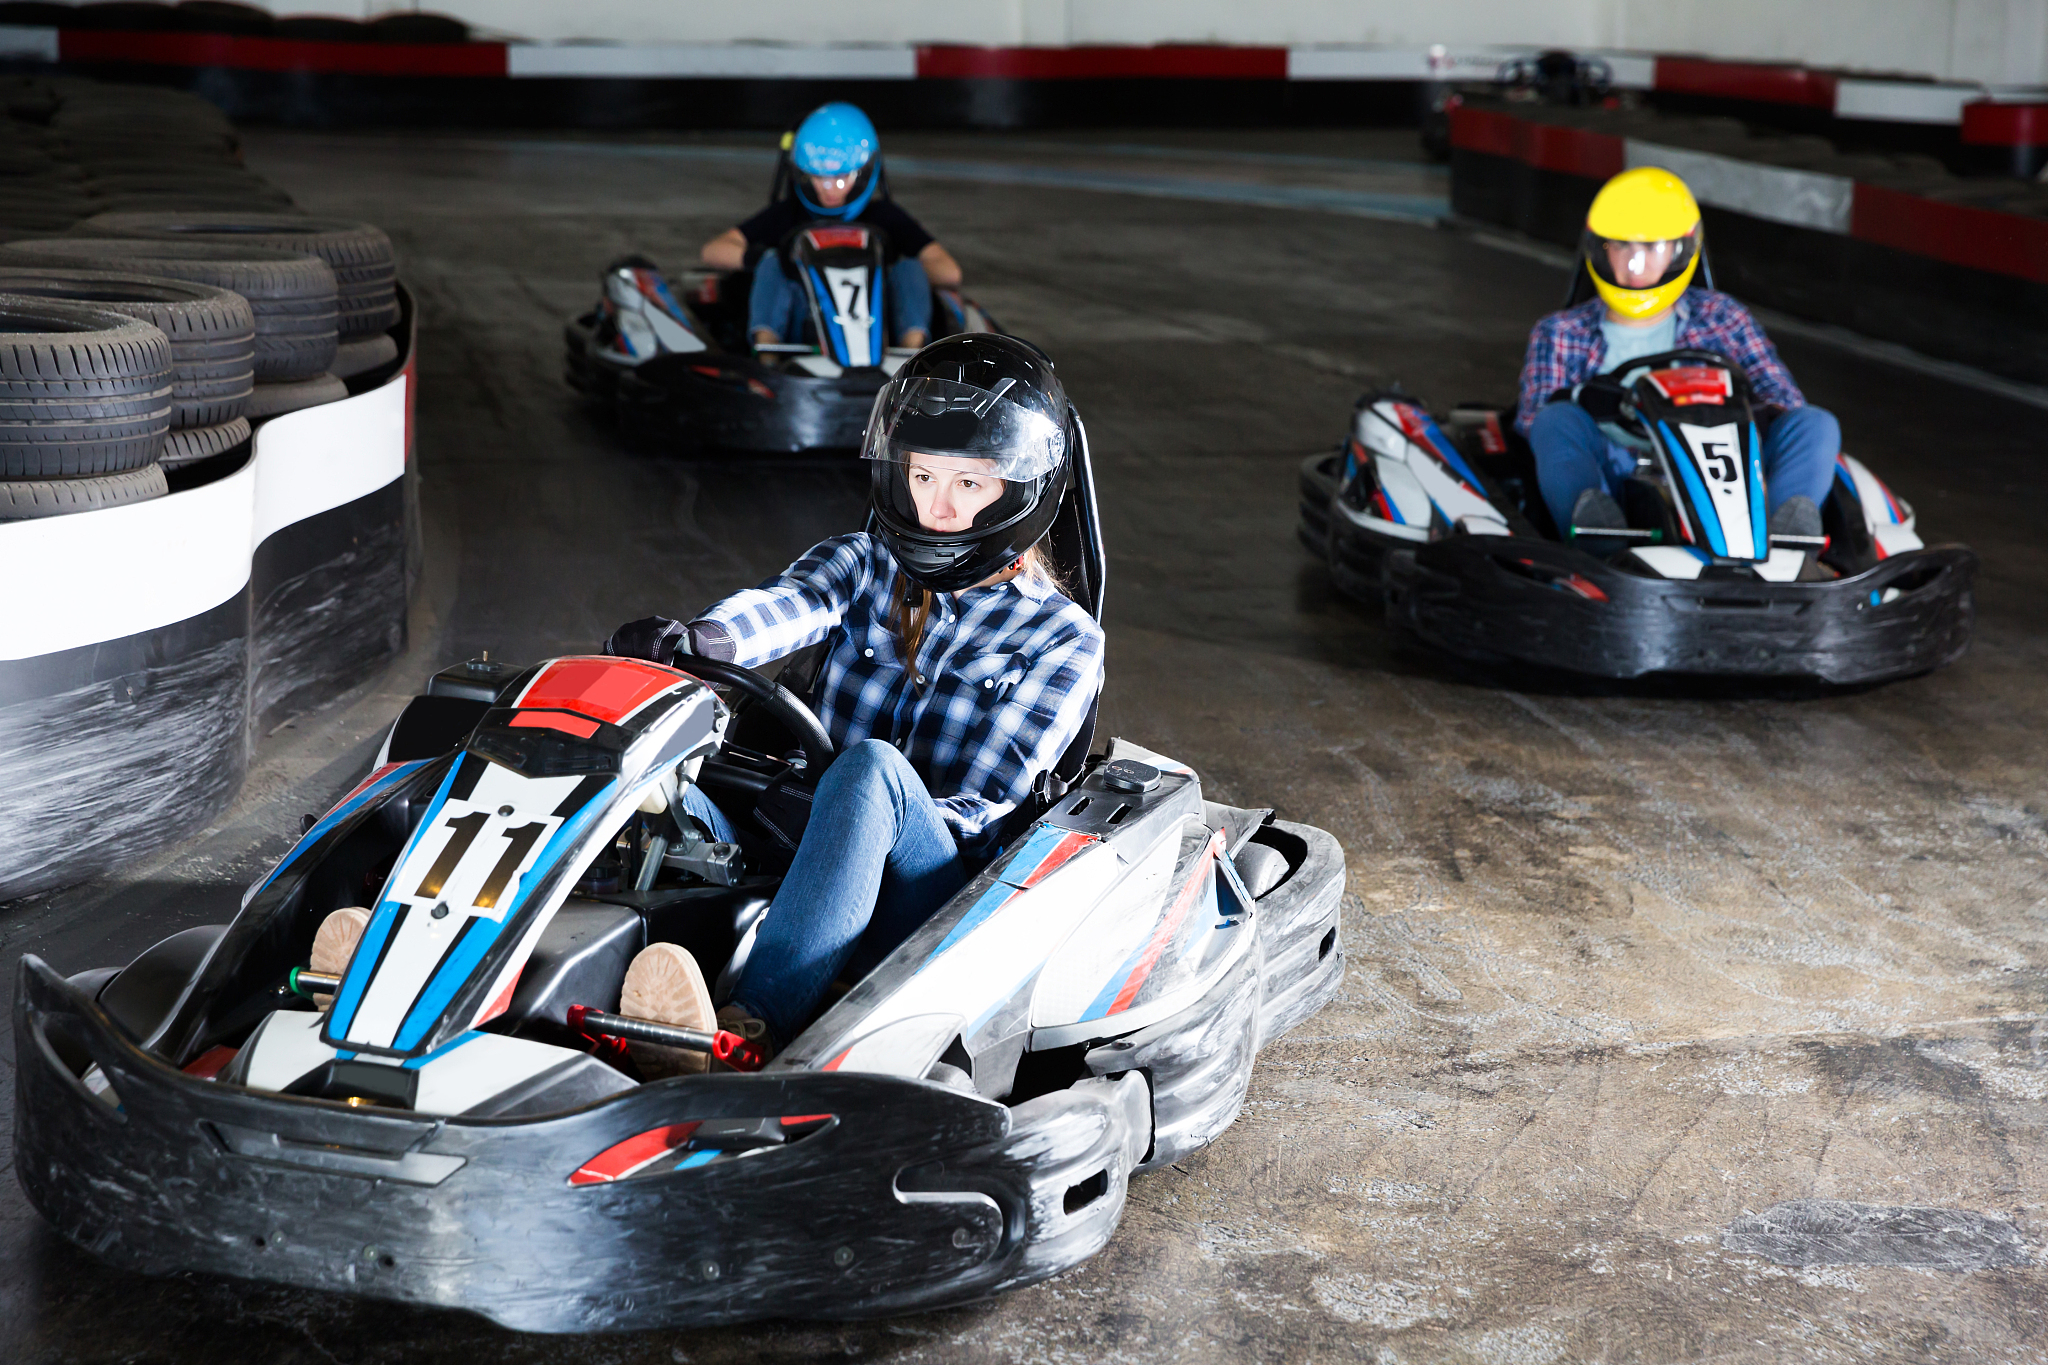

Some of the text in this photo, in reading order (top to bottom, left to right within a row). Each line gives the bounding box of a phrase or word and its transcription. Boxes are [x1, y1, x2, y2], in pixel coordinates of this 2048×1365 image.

[841, 280, 860, 319] 7
[1701, 443, 1738, 482] 5
[413, 811, 549, 909] 11
